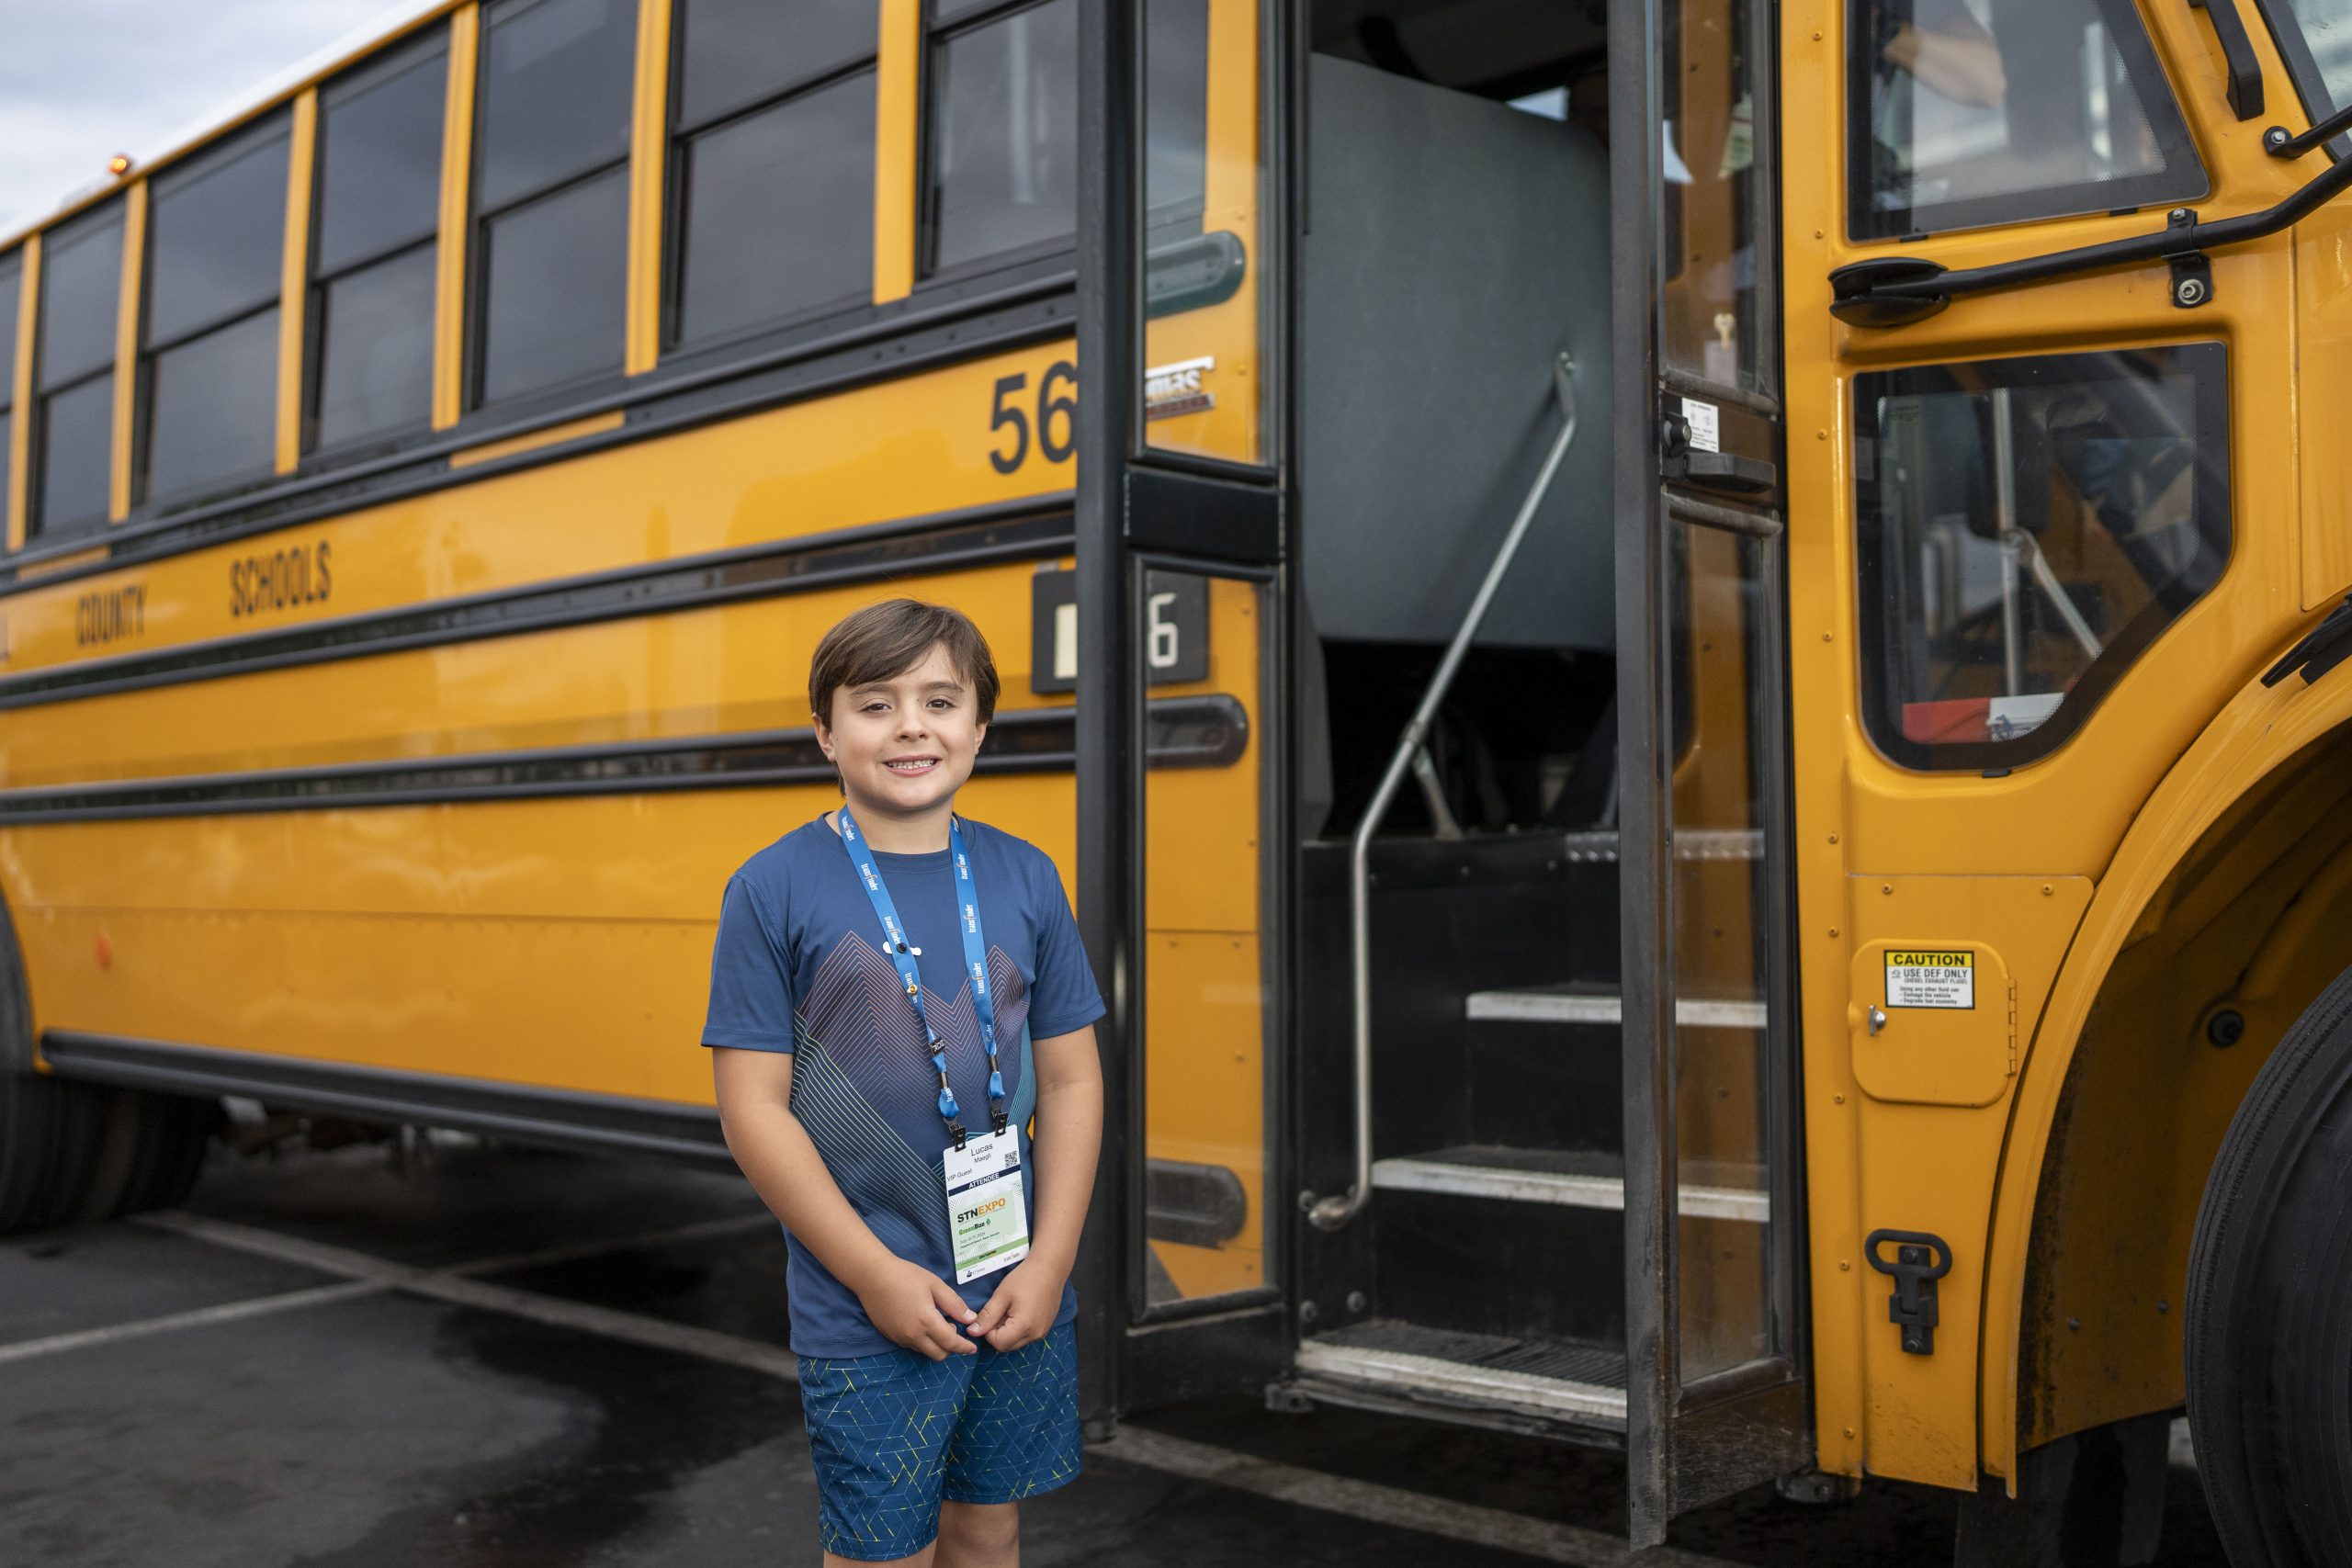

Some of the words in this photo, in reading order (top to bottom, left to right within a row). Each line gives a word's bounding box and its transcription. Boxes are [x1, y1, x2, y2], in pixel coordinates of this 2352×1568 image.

[989, 360, 1078, 474] 56
[78, 585, 148, 646] COUNTY
[232, 540, 332, 616] SCHOOLS
[861, 863, 878, 891] transfinder
[963, 903, 975, 933] transfinder
[1894, 954, 1965, 965] CAUTION
[972, 962, 985, 995] transfinder
[1904, 968, 1921, 977] USE
[1924, 968, 1941, 977] DEF
[1944, 969, 1968, 978] ONLY
[970, 1143, 993, 1156] Lucas
[946, 1174, 956, 1182] VIP
[957, 1168, 973, 1179] Guest
[968, 1172, 1000, 1189] ATTENDEE
[957, 1198, 1006, 1223] STNEXPO
[959, 1222, 985, 1235] GreenBus
